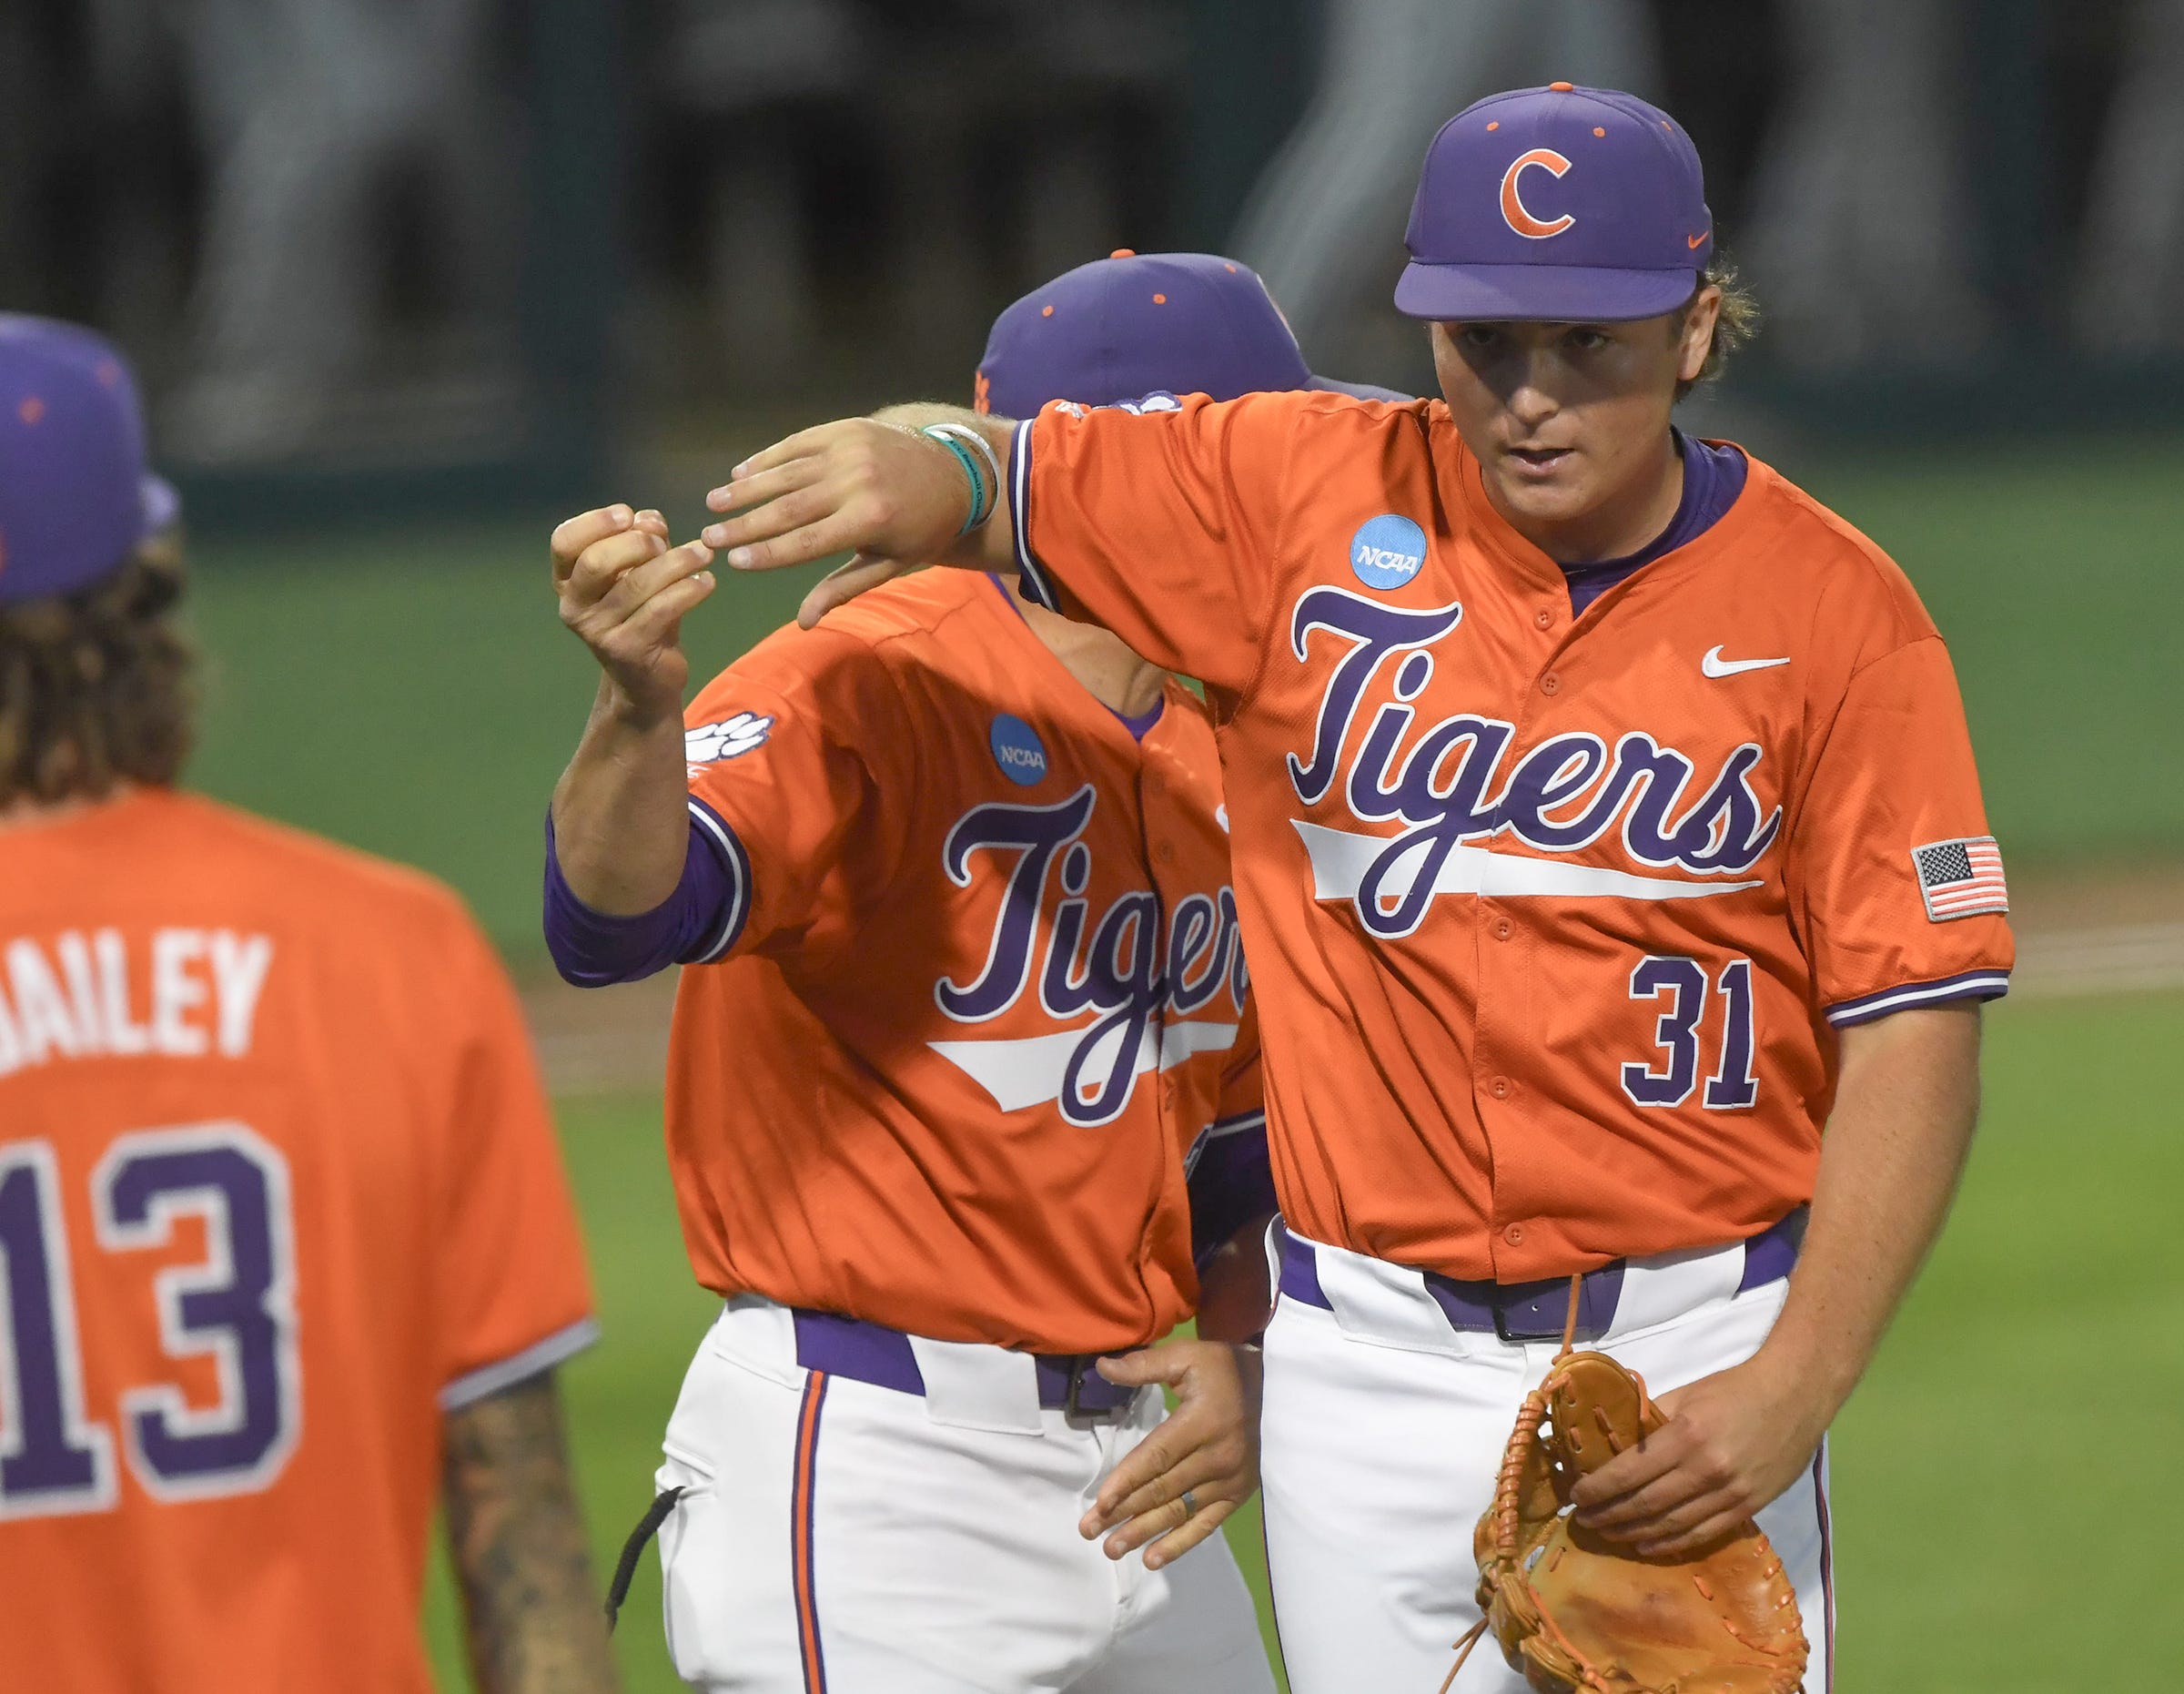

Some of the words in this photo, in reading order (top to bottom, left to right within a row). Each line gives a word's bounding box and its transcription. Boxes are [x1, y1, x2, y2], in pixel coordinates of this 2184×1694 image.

[1500, 148, 1576, 239] C
[1356, 544, 1419, 575] NCAA
[1000, 744, 1046, 771] NCAA
[1286, 584, 1783, 939] Tigers
[0, 926, 273, 1078] AILEY
[935, 783, 1249, 1127] Tiger
[1621, 955, 1759, 1109] 31
[0, 1121, 303, 1522] 13
